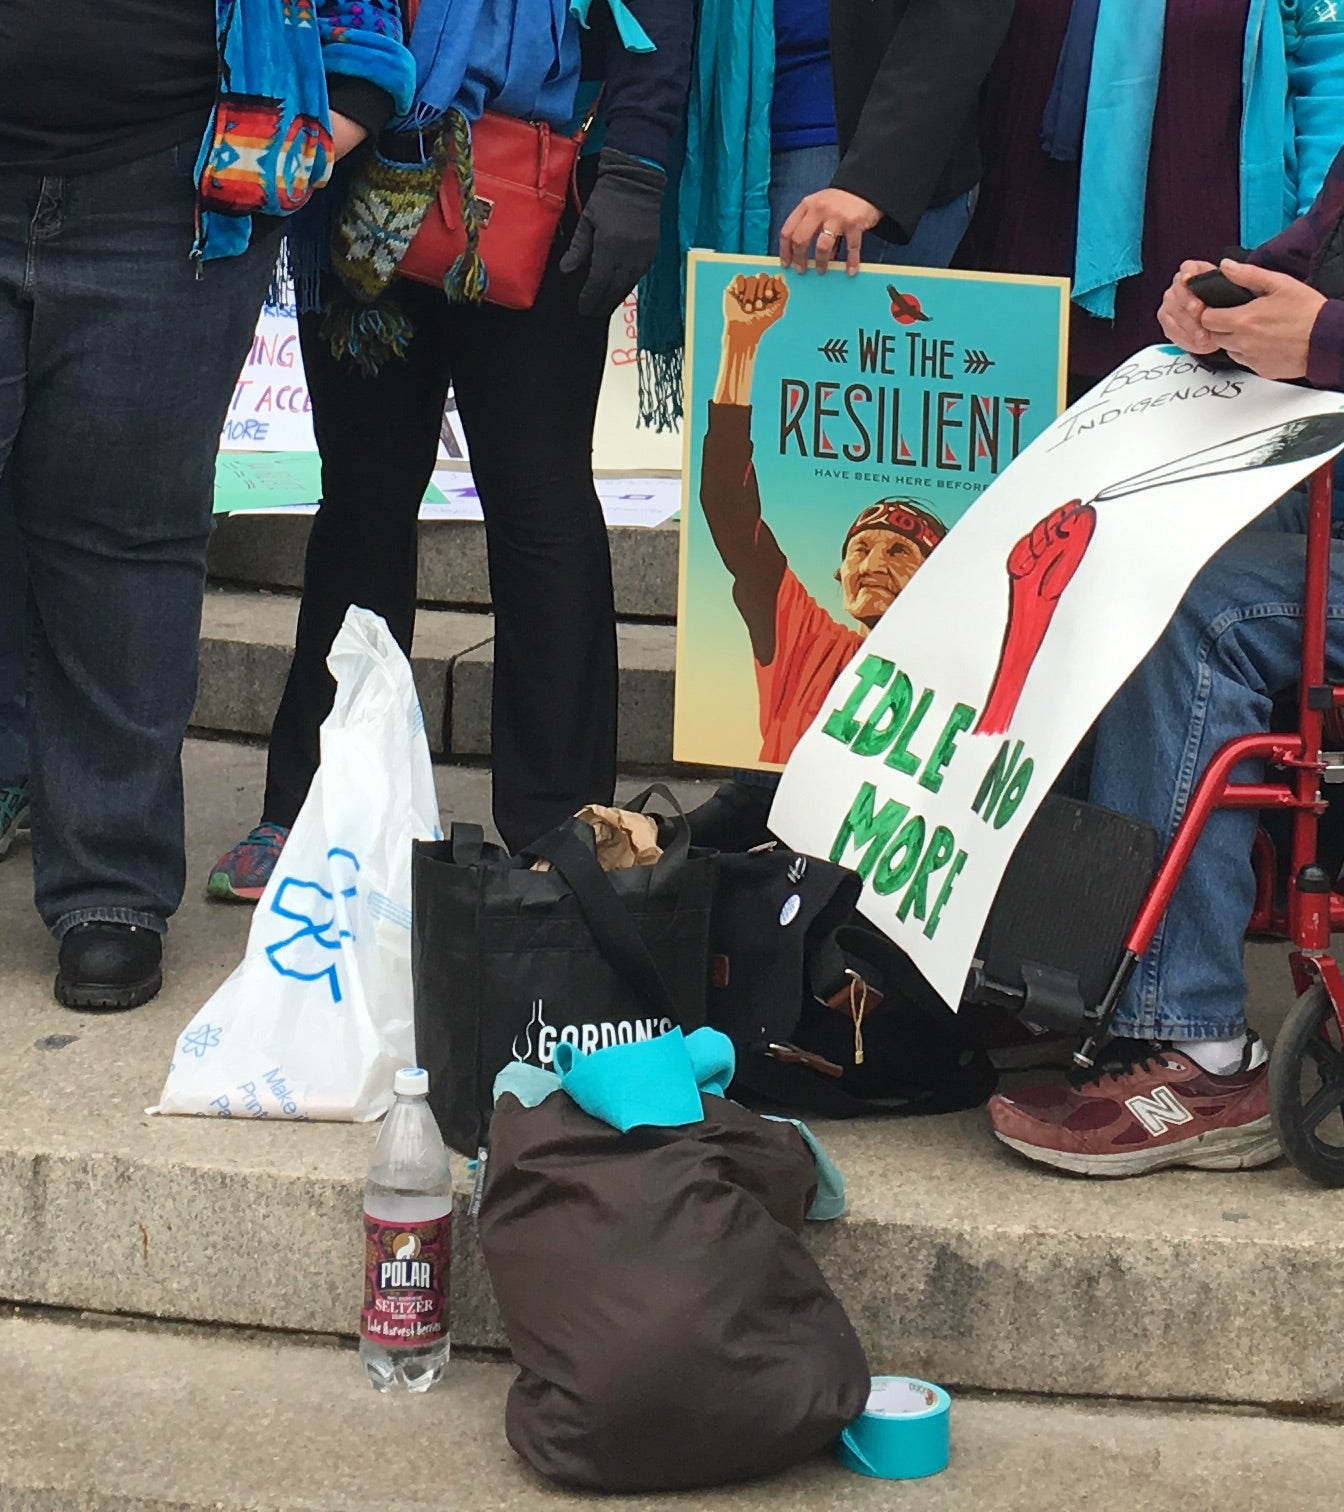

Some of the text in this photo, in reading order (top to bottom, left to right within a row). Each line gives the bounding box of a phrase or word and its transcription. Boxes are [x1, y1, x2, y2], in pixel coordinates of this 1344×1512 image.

[859, 329, 955, 379] WE THE
[779, 377, 1031, 475] RESILIENT
[1046, 380, 1245, 453] INDIGENOUS
[814, 468, 849, 480] HAVE
[854, 472, 890, 483] BEEN
[895, 476, 932, 487] HERE
[821, 654, 1036, 831] IDLE NO
[829, 781, 968, 941] MORE
[538, 1017, 673, 1064] GORDON'S
[236, 1080, 270, 1120] Print
[262, 1066, 297, 1116] Make
[1125, 1086, 1194, 1137] N
[381, 1261, 431, 1289] POLAR
[375, 1298, 433, 1314] SELTZER
